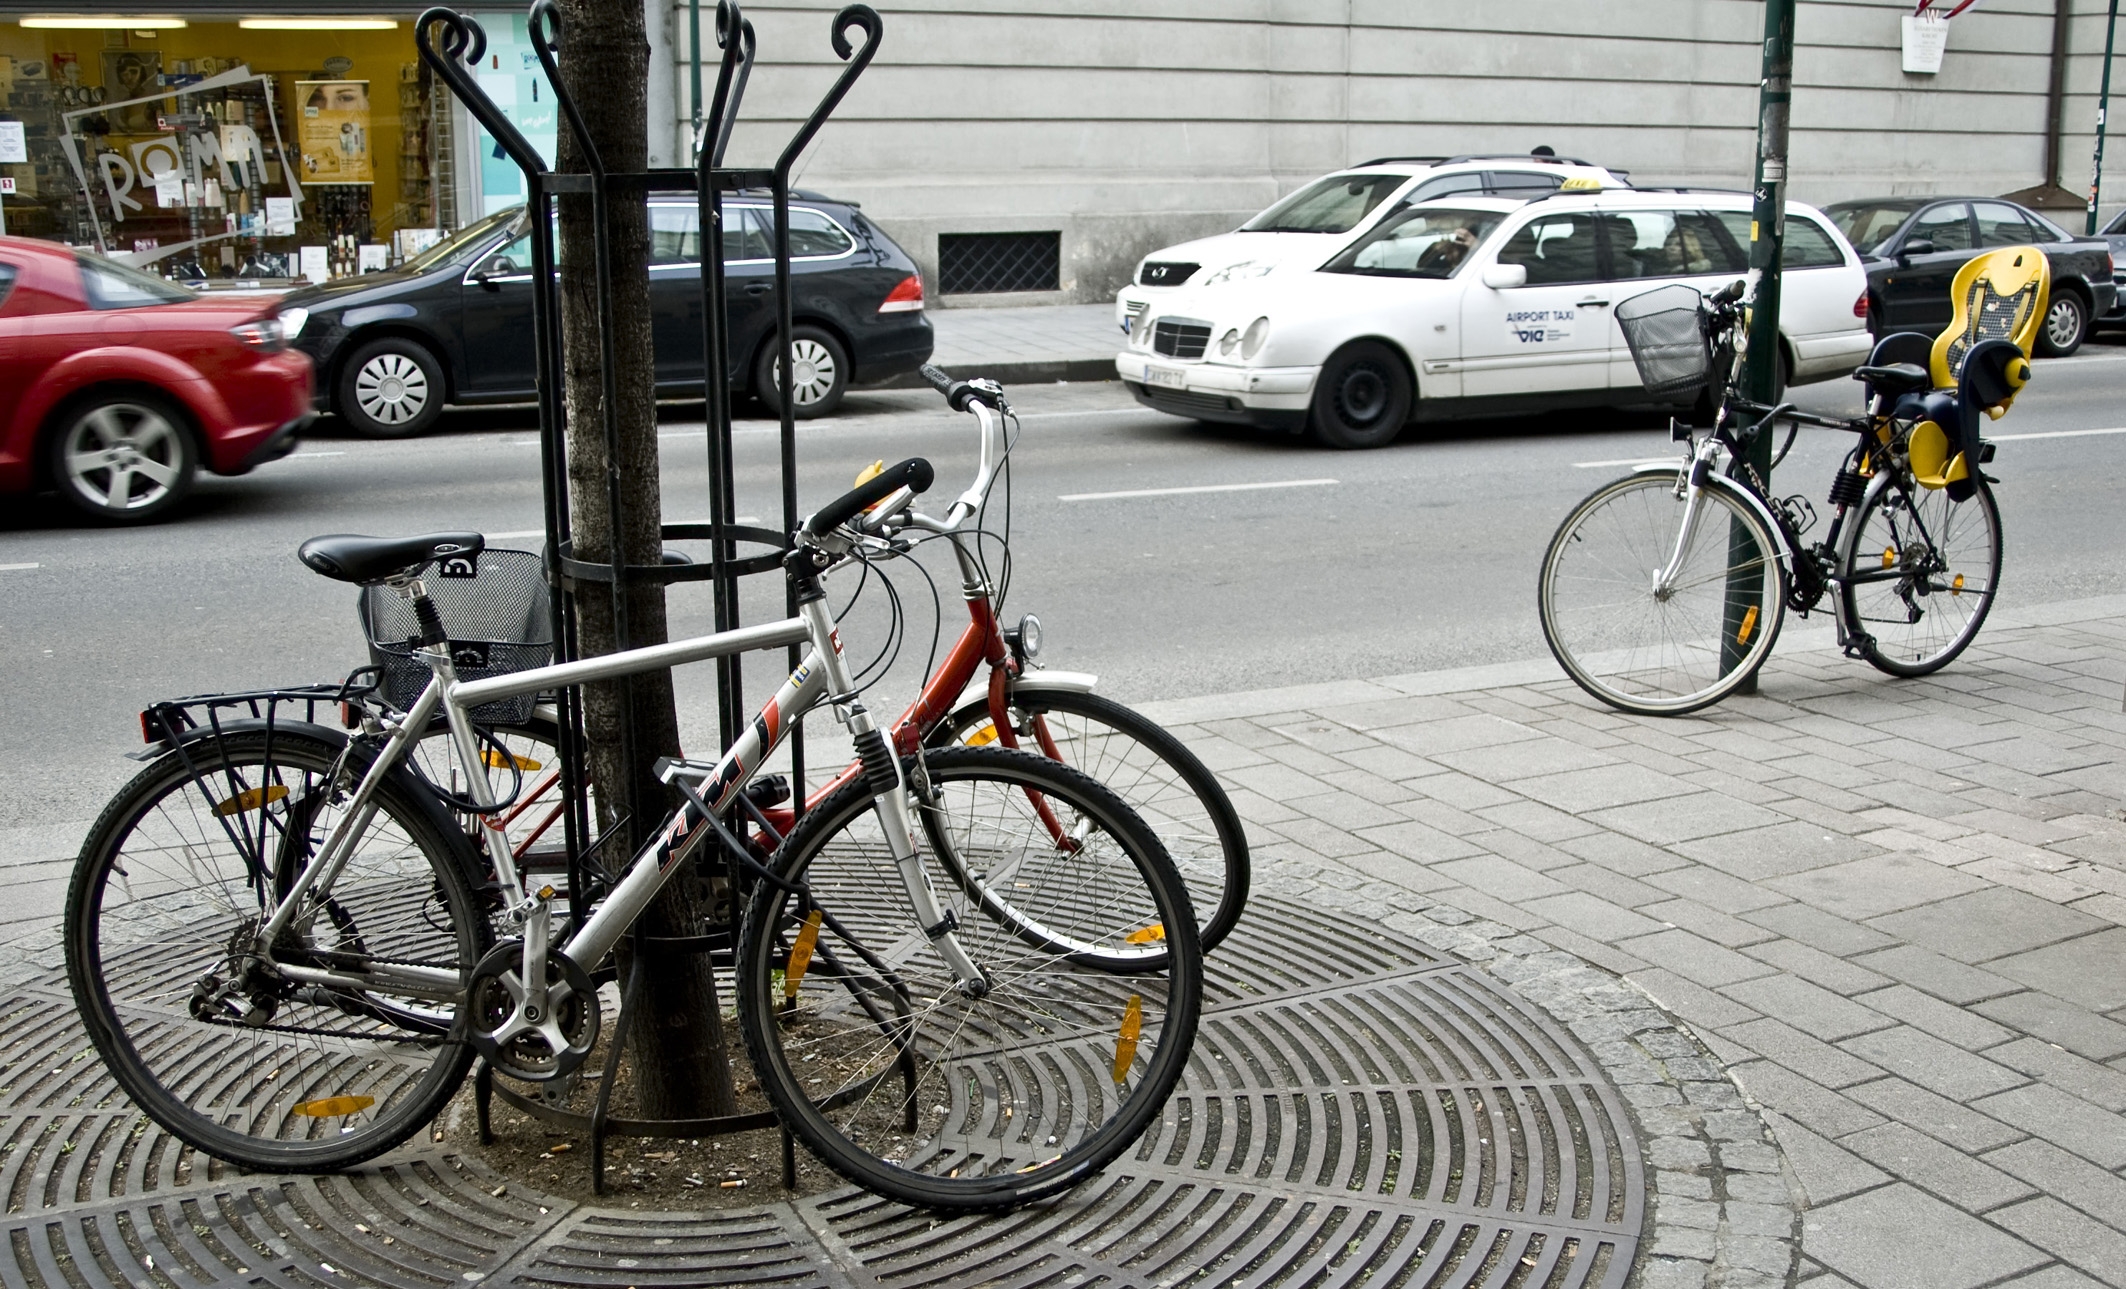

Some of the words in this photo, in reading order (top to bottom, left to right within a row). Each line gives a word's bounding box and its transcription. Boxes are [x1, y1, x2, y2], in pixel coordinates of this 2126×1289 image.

[98, 124, 269, 223] ROMA
[1506, 311, 1549, 322] AIRPORT
[1553, 310, 1574, 321] TAXI
